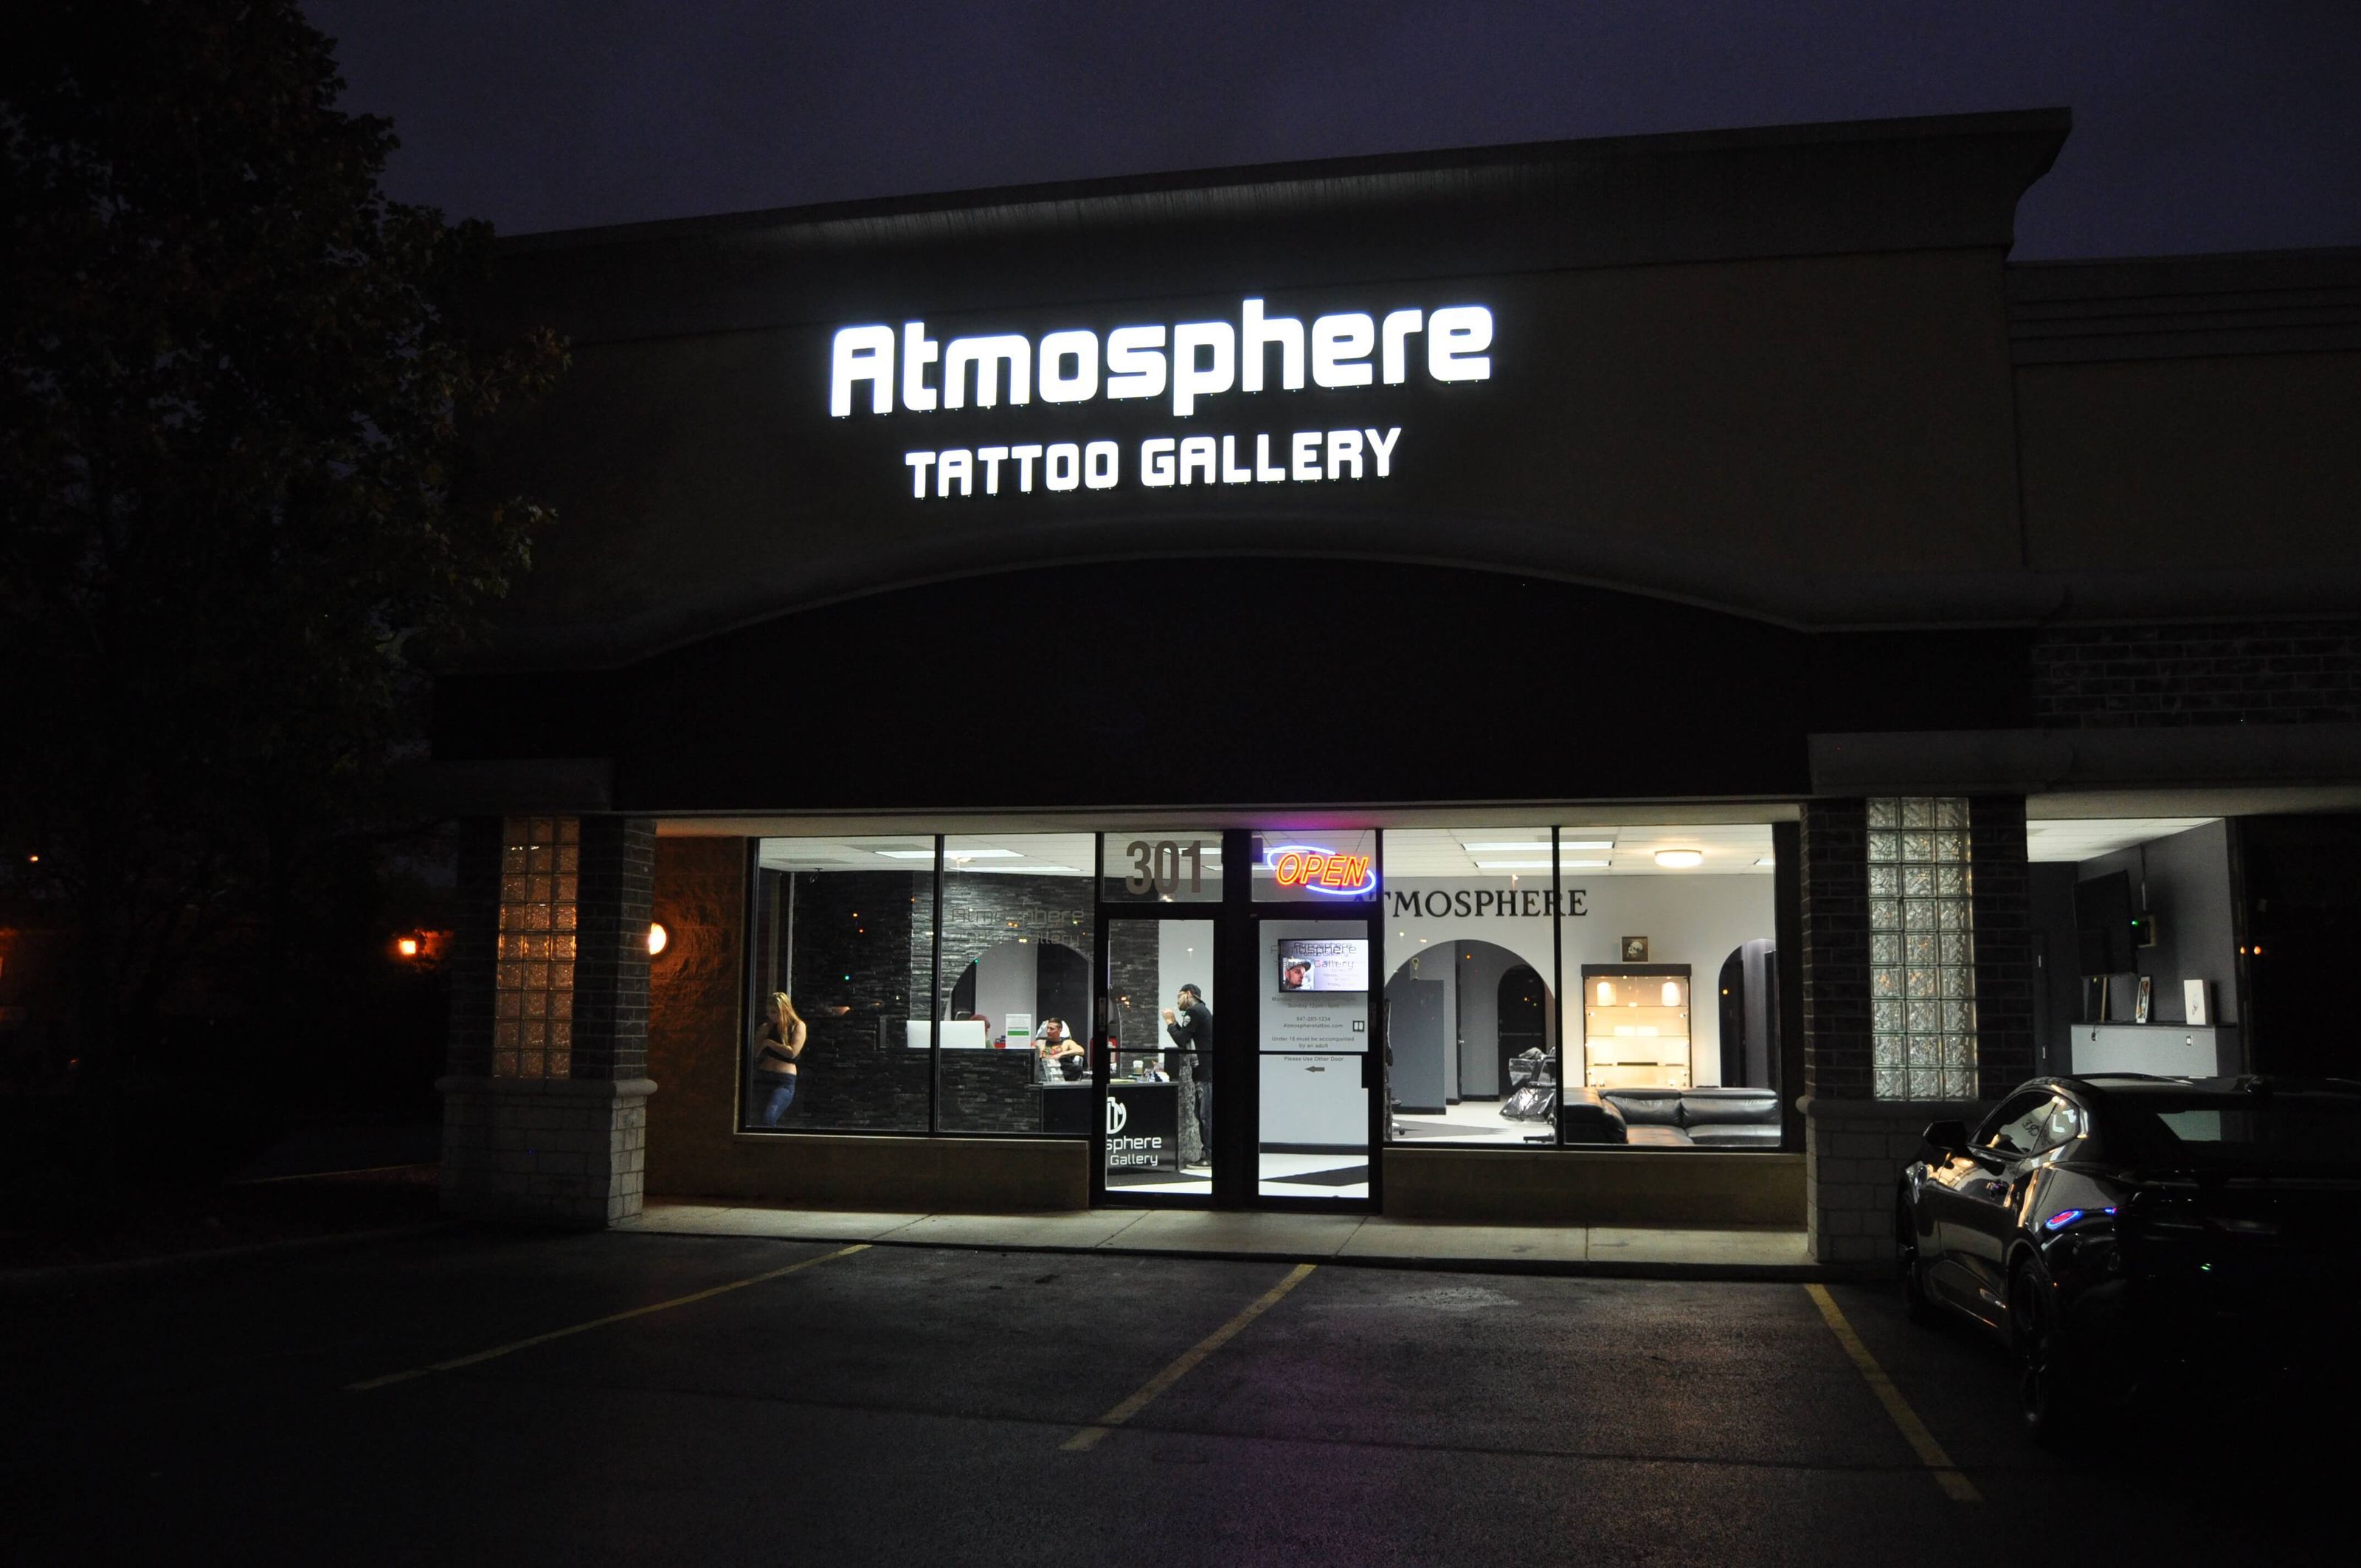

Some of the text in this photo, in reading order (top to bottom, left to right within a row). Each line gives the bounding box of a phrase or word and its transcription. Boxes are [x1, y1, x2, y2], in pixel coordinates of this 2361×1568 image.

[831, 298, 1493, 417] Atmosphere
[905, 427, 1402, 498] TATTOO GALLERY
[1126, 840, 1201, 895] 301
[1276, 852, 1369, 887] OPEN
[1354, 890, 1588, 918] MOSPHERE
[1110, 1153, 1158, 1166] Gallery
